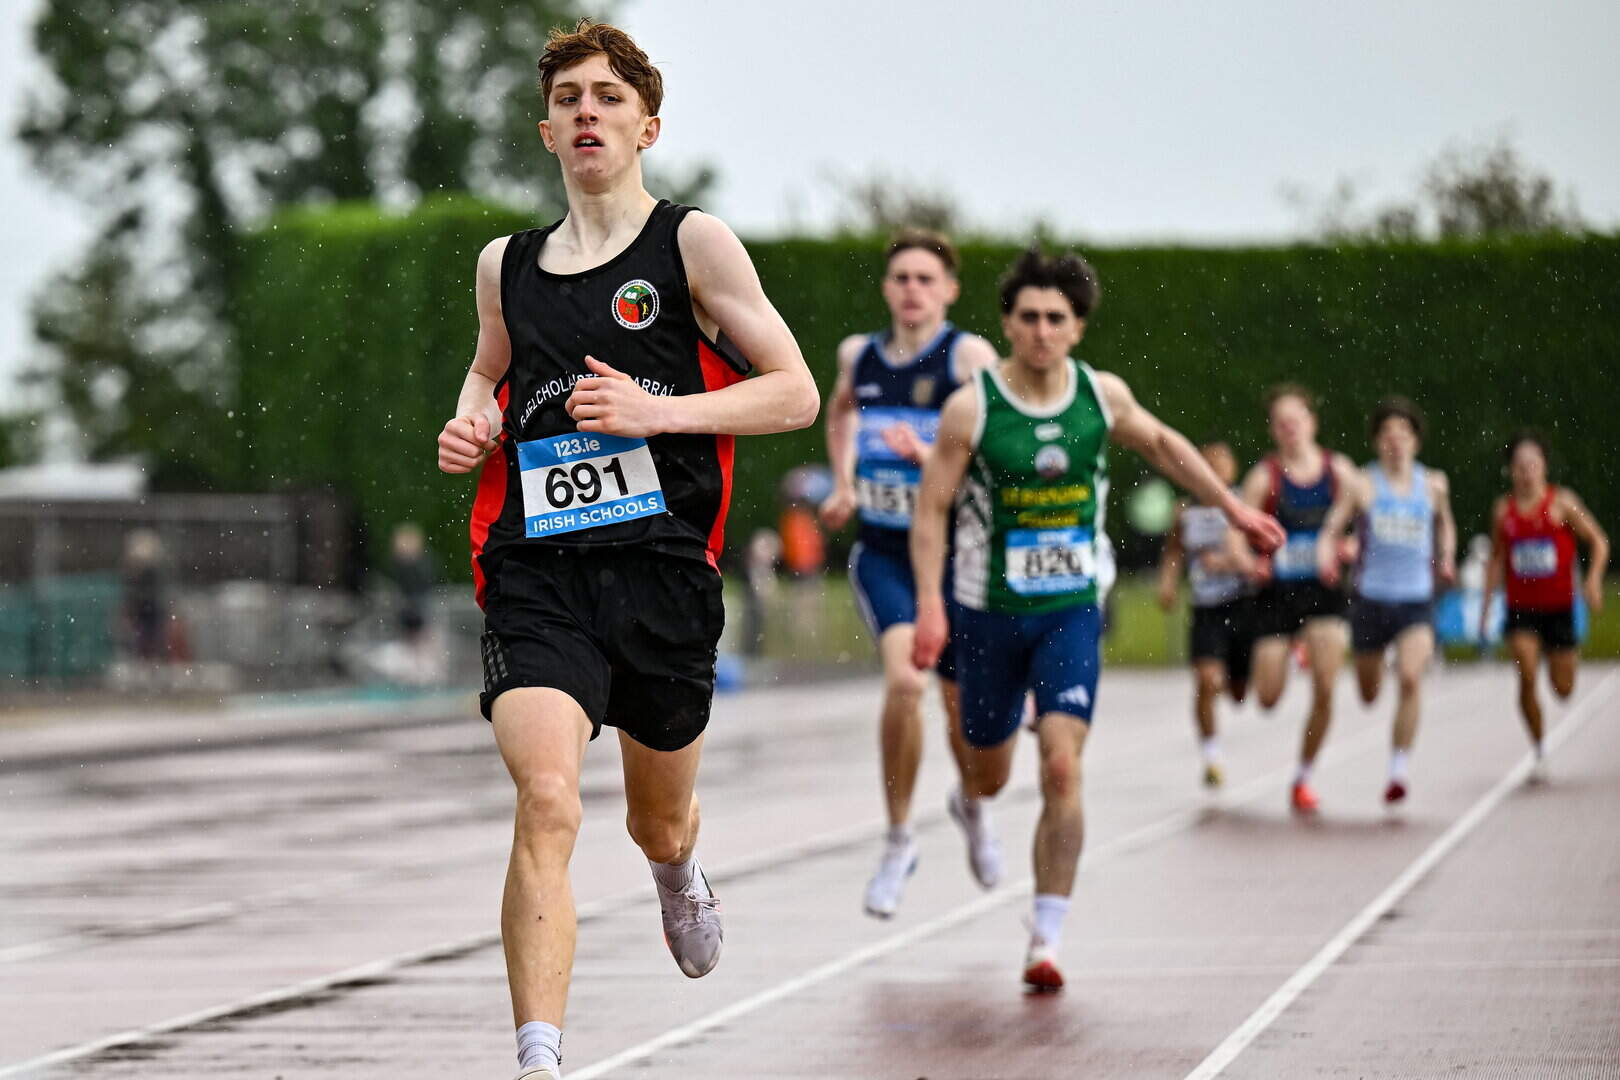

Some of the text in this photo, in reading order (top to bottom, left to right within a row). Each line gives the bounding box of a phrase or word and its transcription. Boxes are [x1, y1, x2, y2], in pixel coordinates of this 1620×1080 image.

[553, 437, 601, 458] 123.ie
[545, 457, 629, 509] 691
[533, 497, 658, 533] IRISH SCHOOLS
